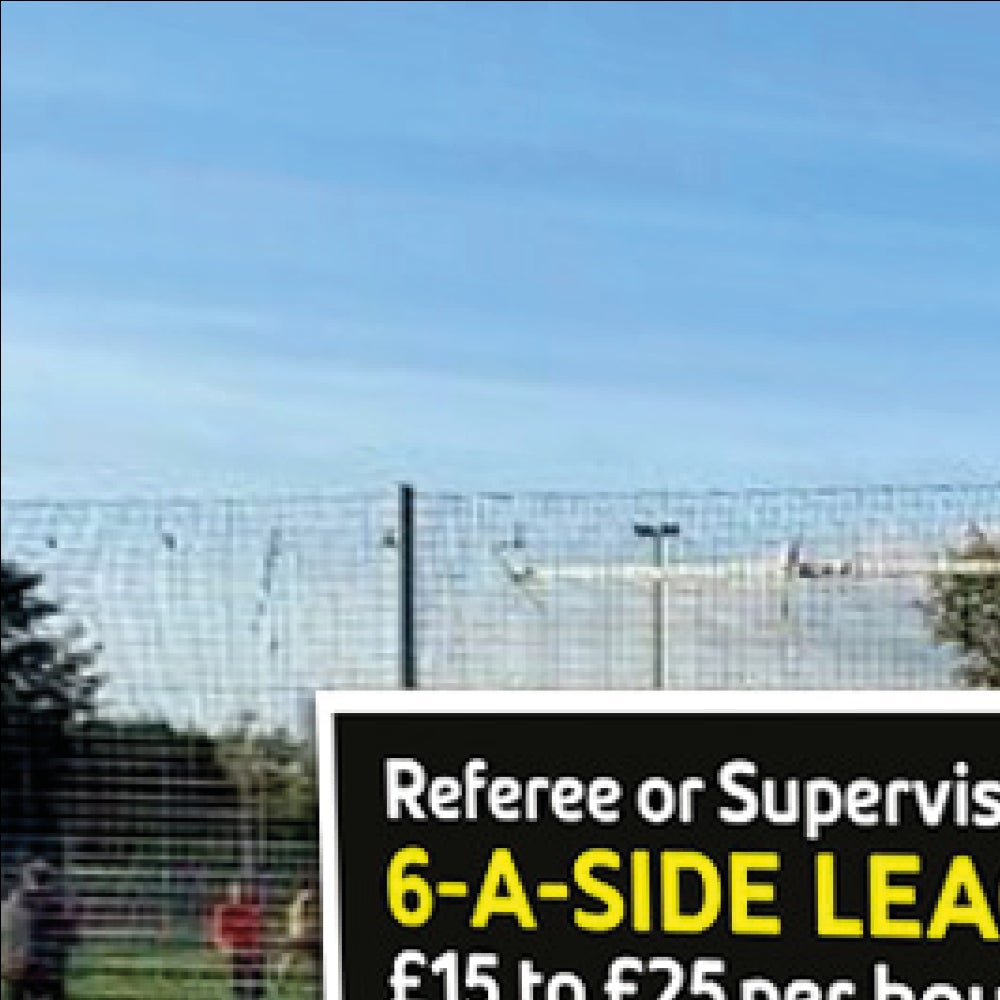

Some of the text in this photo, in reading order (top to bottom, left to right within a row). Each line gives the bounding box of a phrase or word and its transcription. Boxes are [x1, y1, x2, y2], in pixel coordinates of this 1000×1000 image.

[386, 758, 621, 822] Referee
[637, 777, 706, 822] or
[386, 848, 782, 935] 6-A-SIDE
